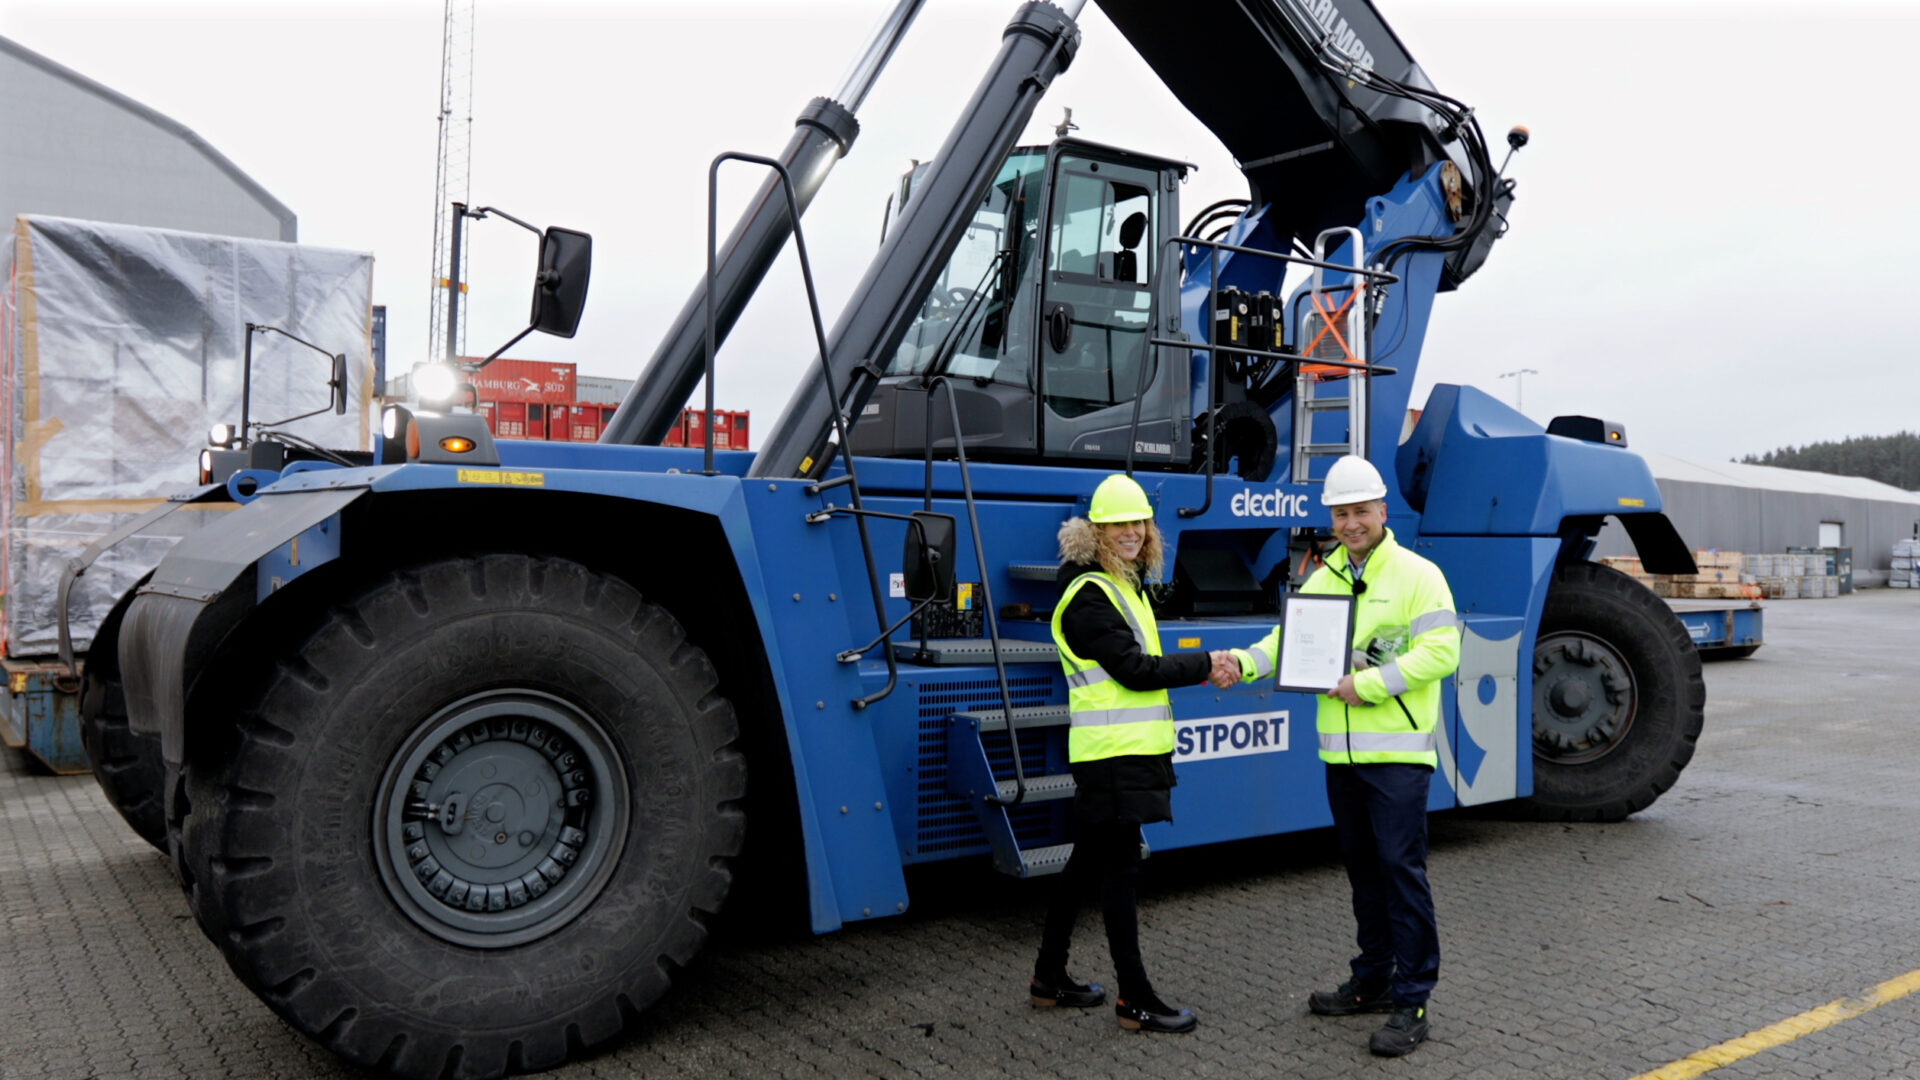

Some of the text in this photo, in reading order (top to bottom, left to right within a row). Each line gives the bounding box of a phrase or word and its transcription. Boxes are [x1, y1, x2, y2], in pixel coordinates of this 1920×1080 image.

[545, 381, 565, 393] SÜD
[1231, 488, 1308, 517] electric
[1173, 717, 1285, 756] STPORT
